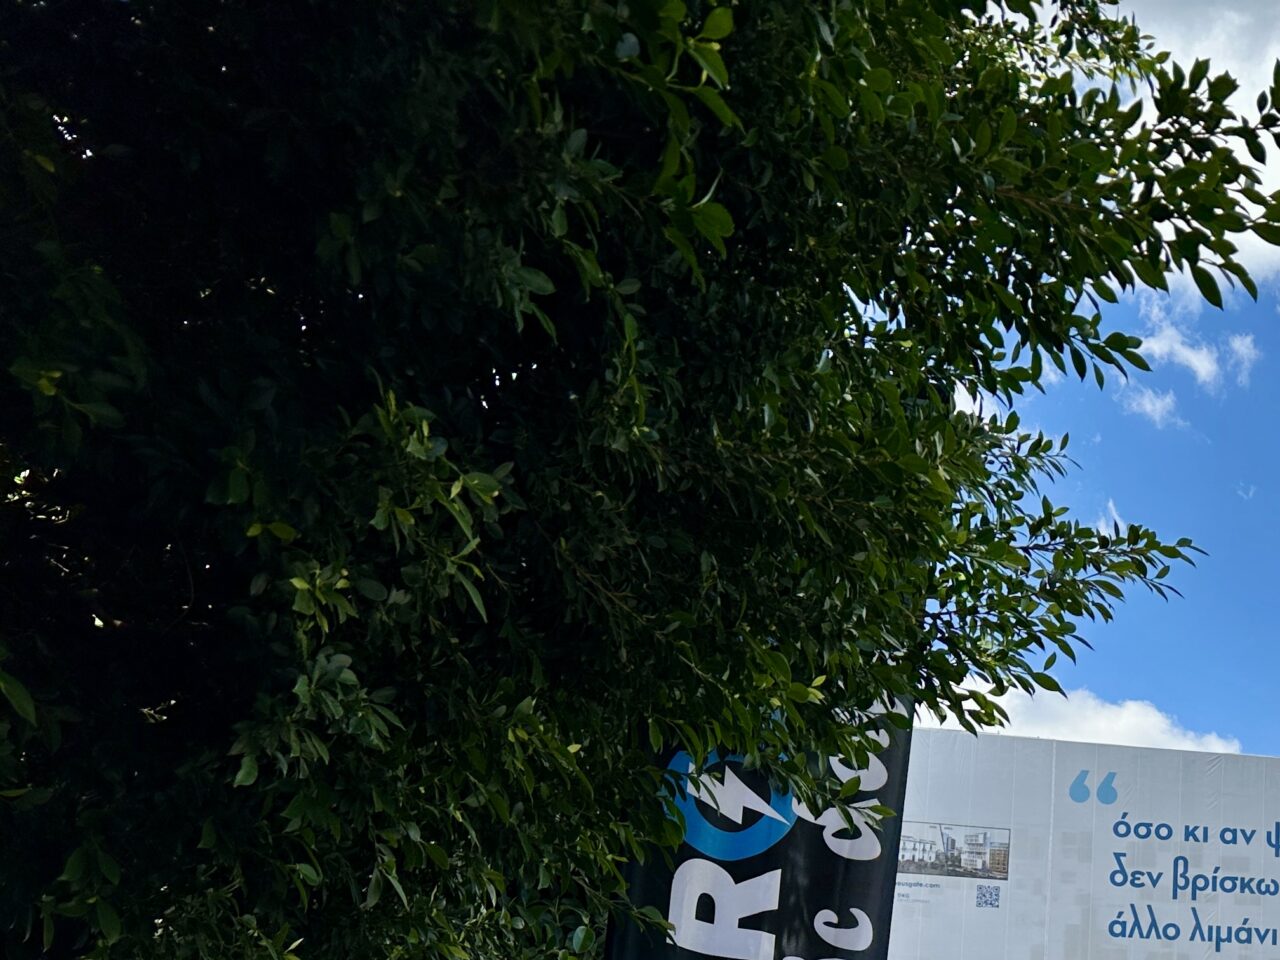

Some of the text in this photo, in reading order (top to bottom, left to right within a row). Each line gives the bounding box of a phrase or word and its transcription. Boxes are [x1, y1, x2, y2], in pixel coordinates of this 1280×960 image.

[1112, 812, 1174, 841] όσο
[1183, 824, 1209, 844] κι
[1219, 826, 1257, 846] αν
[1109, 852, 1280, 901] δεν βρίσκω
[1108, 903, 1181, 942] άλλο
